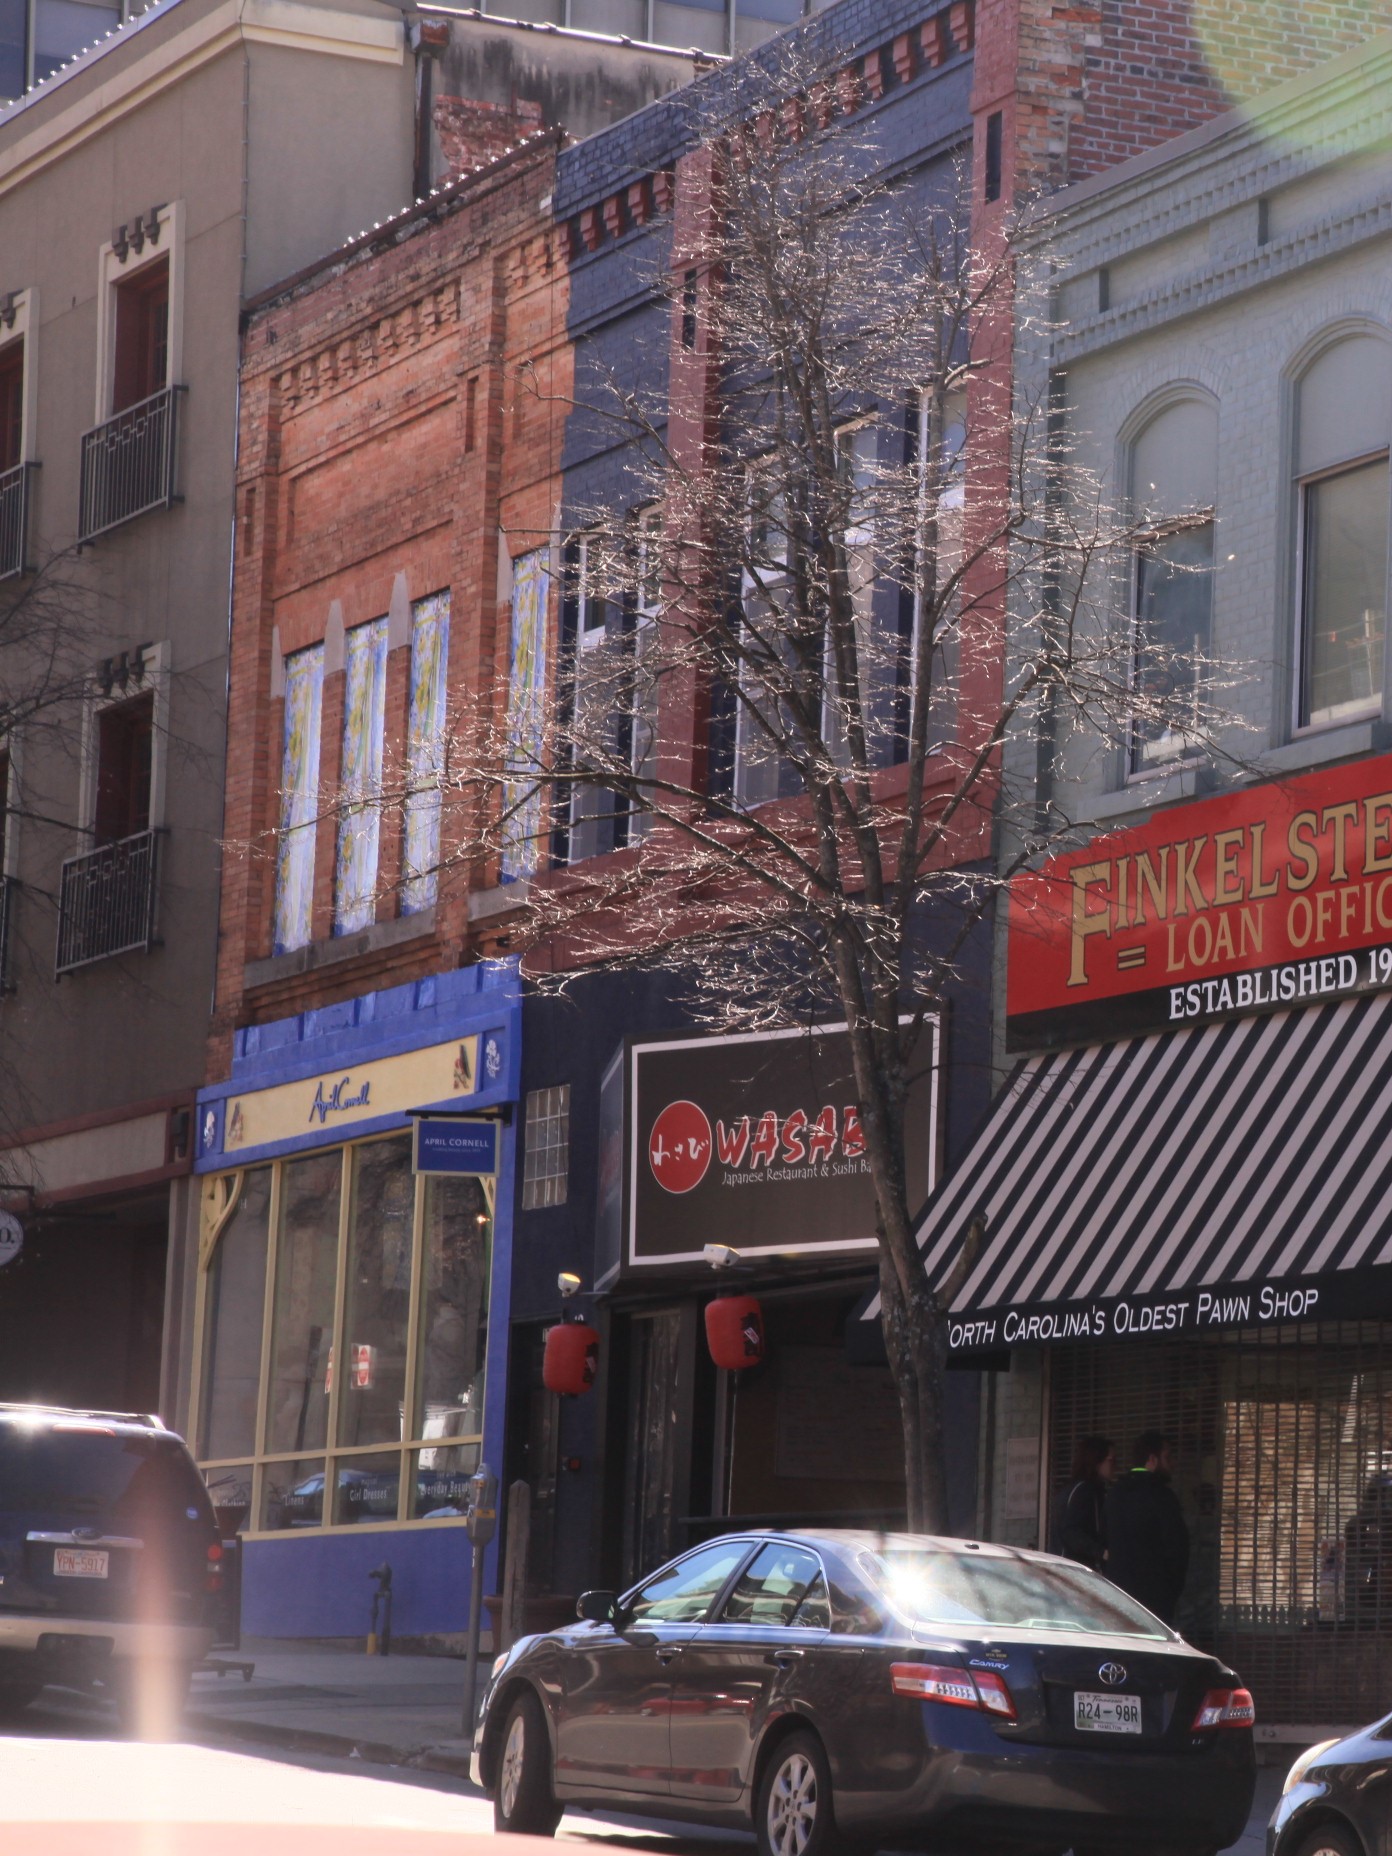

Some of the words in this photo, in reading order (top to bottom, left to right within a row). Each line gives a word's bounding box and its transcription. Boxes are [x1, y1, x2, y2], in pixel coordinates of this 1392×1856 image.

[1165, 902, 1264, 973] LOAN
[1169, 955, 1358, 1020] ESTABLISHED
[309, 1081, 338, 1123] April
[336, 1077, 370, 1111] Cornell
[424, 1138, 446, 1146] APRIL
[449, 1138, 489, 1148] CORNELL
[716, 1105, 868, 1169] WASAB
[721, 1170, 763, 1187] Japanese
[766, 1163, 818, 1182] Restaurant
[821, 1163, 829, 1177] &
[832, 1159, 857, 1176] Sushi
[861, 1159, 872, 1173] Ba
[947, 1320, 996, 1348] ORTH
[1003, 1305, 1105, 1342] CAROLINA'S
[1113, 1302, 1189, 1334] OLDEST
[1196, 1293, 1251, 1325] PAWN
[1258, 1286, 1319, 1320] SHOP
[349, 1490, 361, 1502] Girl
[363, 1488, 387, 1500] Dresses
